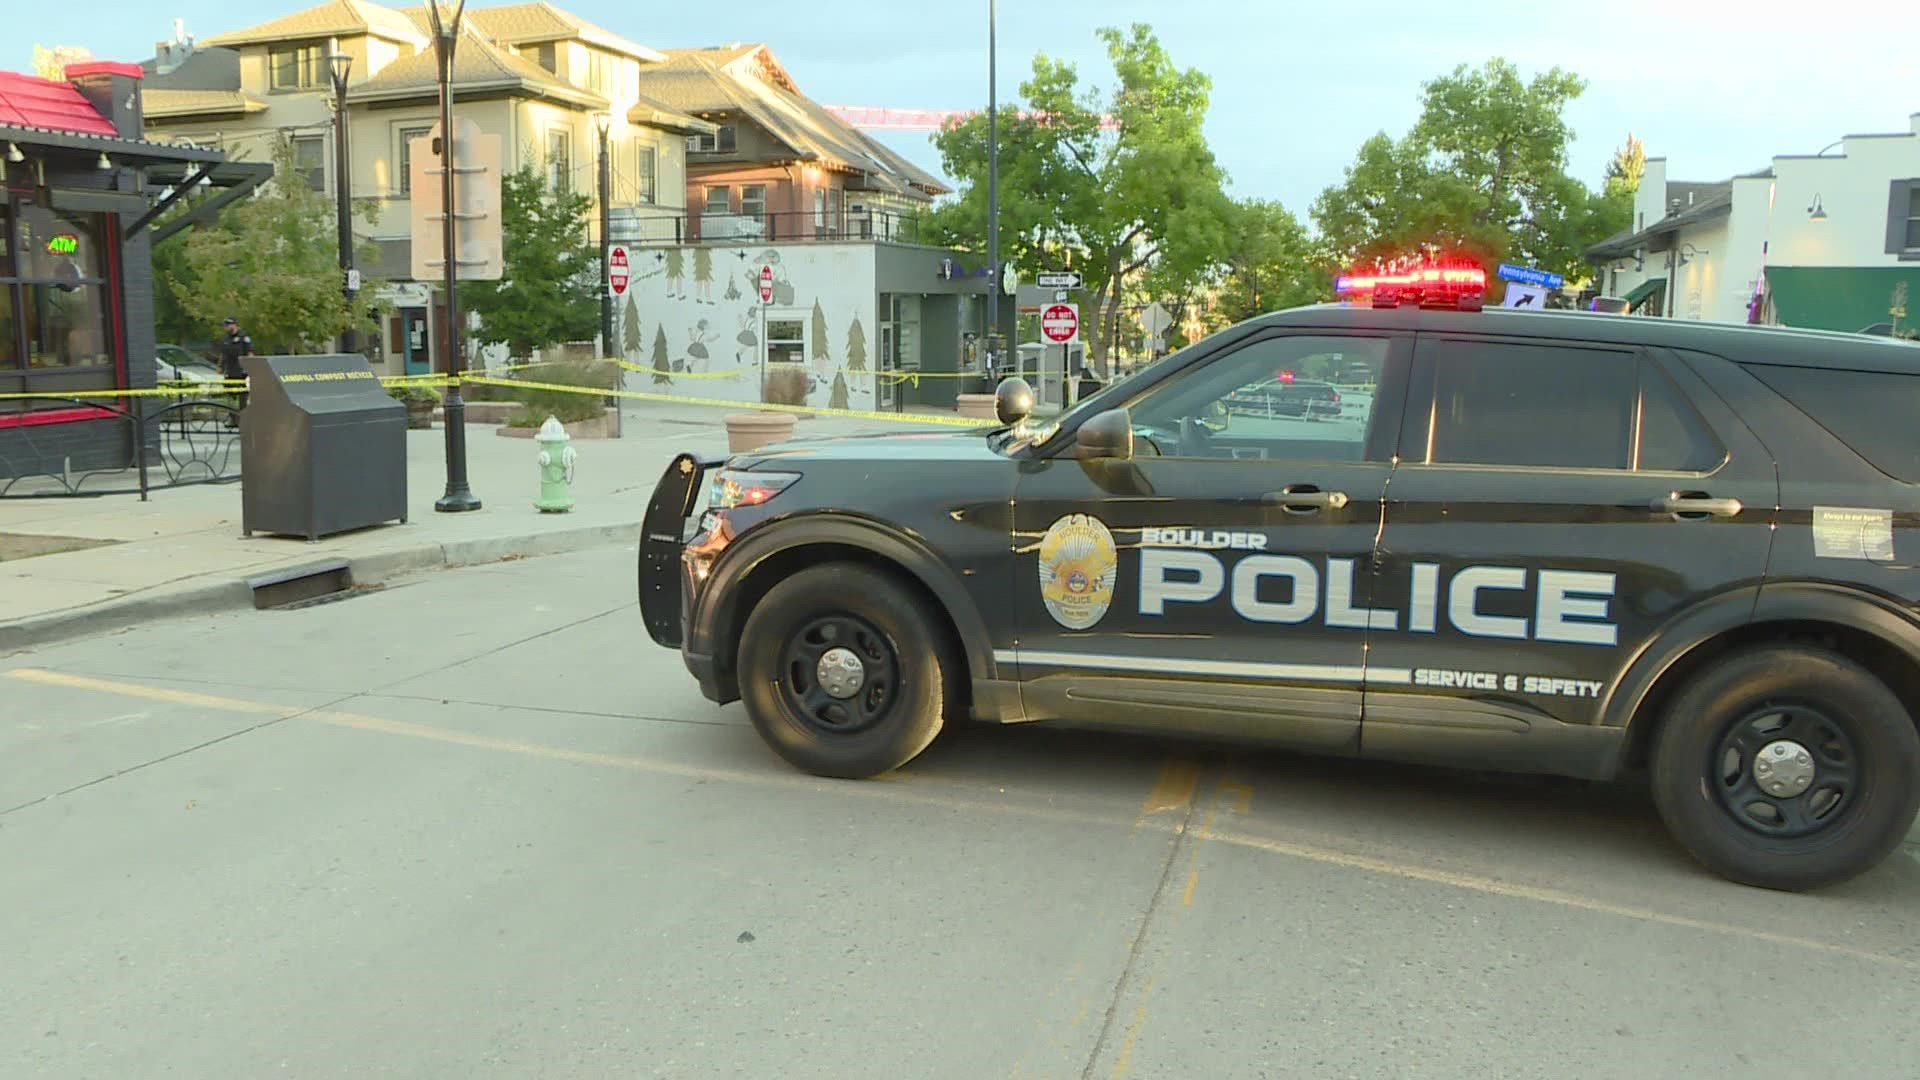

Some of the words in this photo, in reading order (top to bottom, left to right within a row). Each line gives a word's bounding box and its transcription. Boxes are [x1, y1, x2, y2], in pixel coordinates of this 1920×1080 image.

[48, 237, 76, 252] ATM
[1046, 311, 1056, 319] DO
[1059, 311, 1072, 319] NOT
[1049, 328, 1070, 336] ENTER
[1060, 526, 1101, 541] BOULDER
[1141, 527, 1268, 551] BOULDER
[1061, 594, 1092, 604] POLICE
[1138, 548, 1618, 645] POLICE
[1415, 668, 1498, 690] SERVICE
[1503, 674, 1518, 691] &
